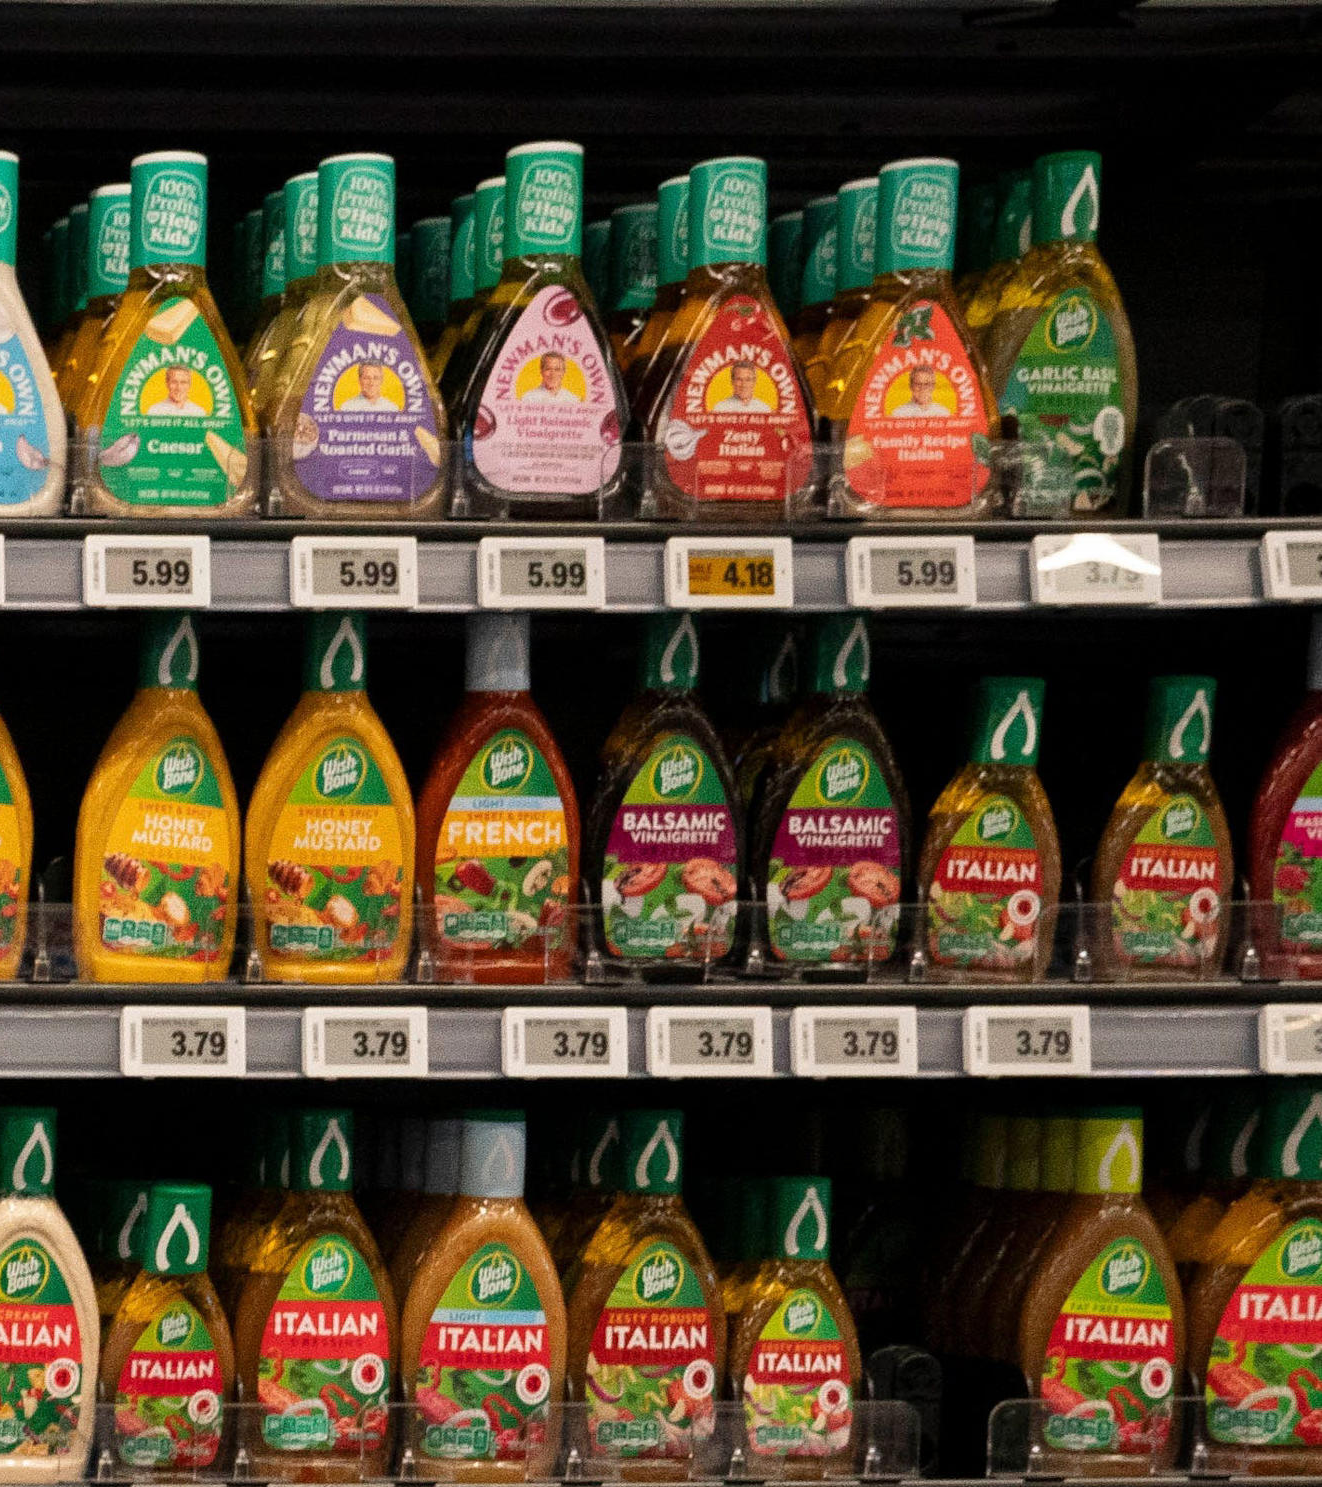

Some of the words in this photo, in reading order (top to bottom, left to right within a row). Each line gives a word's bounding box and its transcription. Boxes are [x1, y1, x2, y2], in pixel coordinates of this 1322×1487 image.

[1016, 366, 1067, 383] GARLIC
[8, 363, 34, 417] OWN
[147, 439, 204, 454] Caesar
[132, 561, 190, 586] 5.99
[526, 562, 585, 589] 5.99
[723, 562, 774, 588] 4.18
[623, 812, 725, 831] BALSAMIC
[789, 817, 891, 835] BALSAMIC
[448, 822, 561, 845] FRENCH
[631, 830, 719, 845] VINAIGRETTE
[797, 834, 884, 848] VINAIGRETTE
[947, 861, 1035, 882] ITALIAN
[171, 1032, 226, 1057] 3.79
[554, 1033, 607, 1056] 3.79
[843, 1032, 897, 1055] 3.79
[7, 1271, 41, 1294] Bone
[274, 1312, 377, 1336] ITALIAN
[1065, 1318, 1168, 1346] ITALIAN
[605, 1325, 707, 1349] ITALIAN
